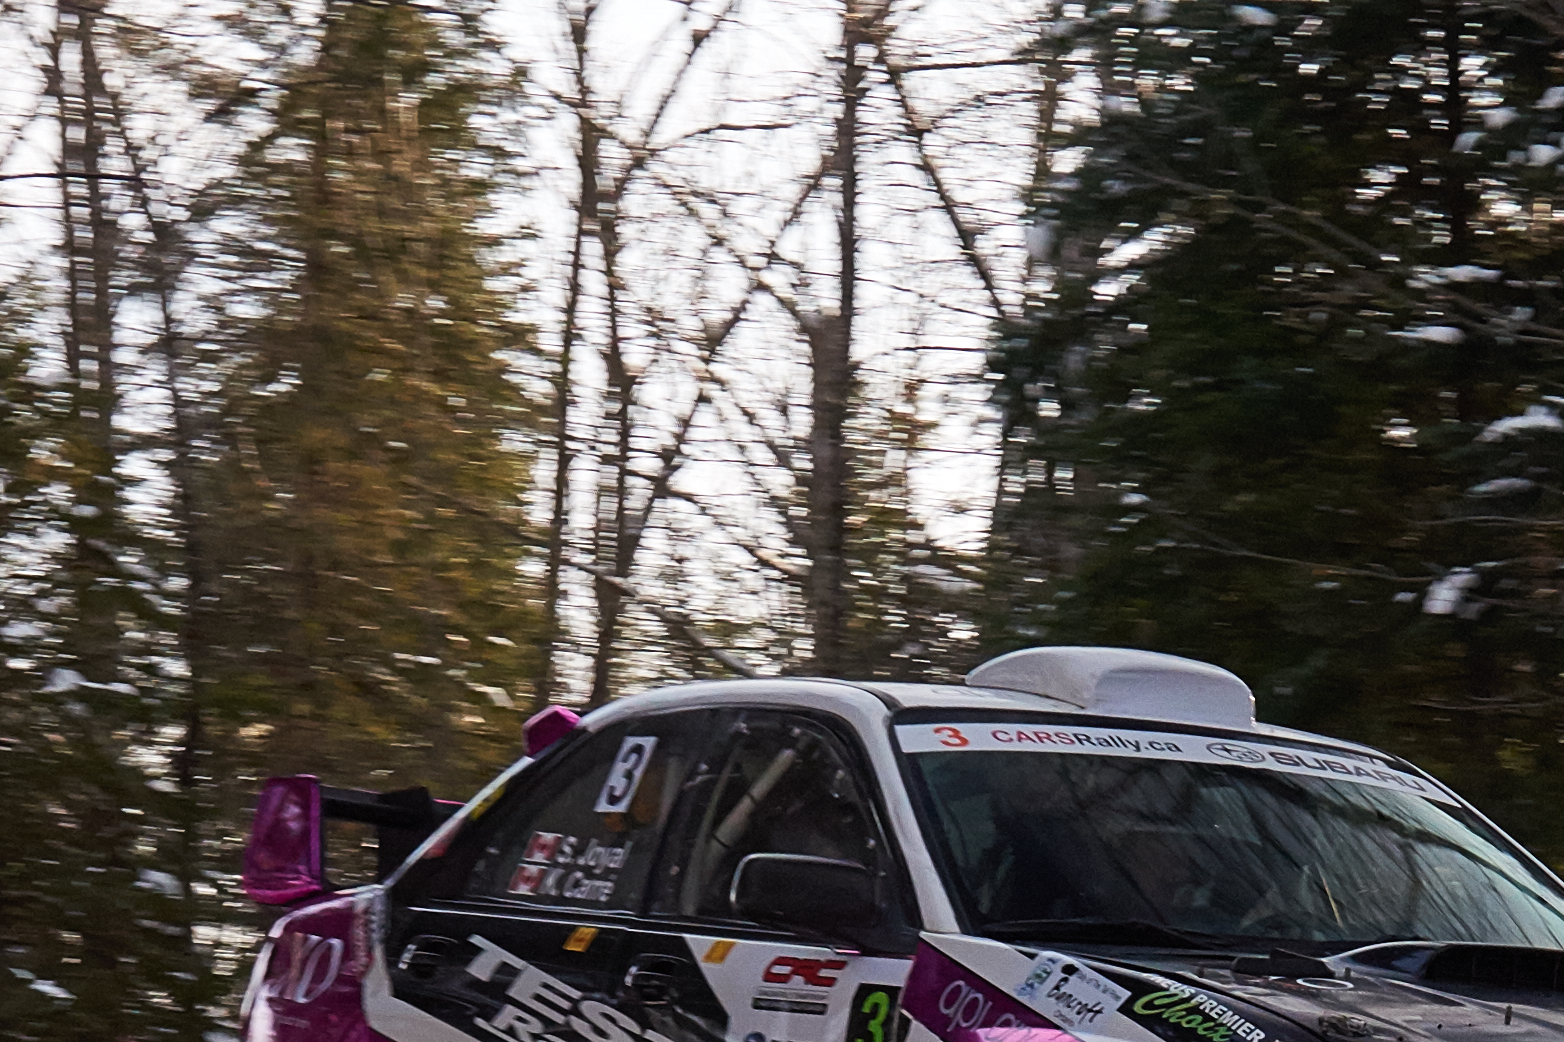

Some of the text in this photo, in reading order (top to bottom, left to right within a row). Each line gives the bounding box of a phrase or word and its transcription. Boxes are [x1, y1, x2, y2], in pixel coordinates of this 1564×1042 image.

[605, 742, 646, 807] 3
[932, 727, 1428, 793] 3 CARSRally.ca SUBARU
[762, 956, 848, 988] CRC
[1133, 990, 1234, 1042] Choix
